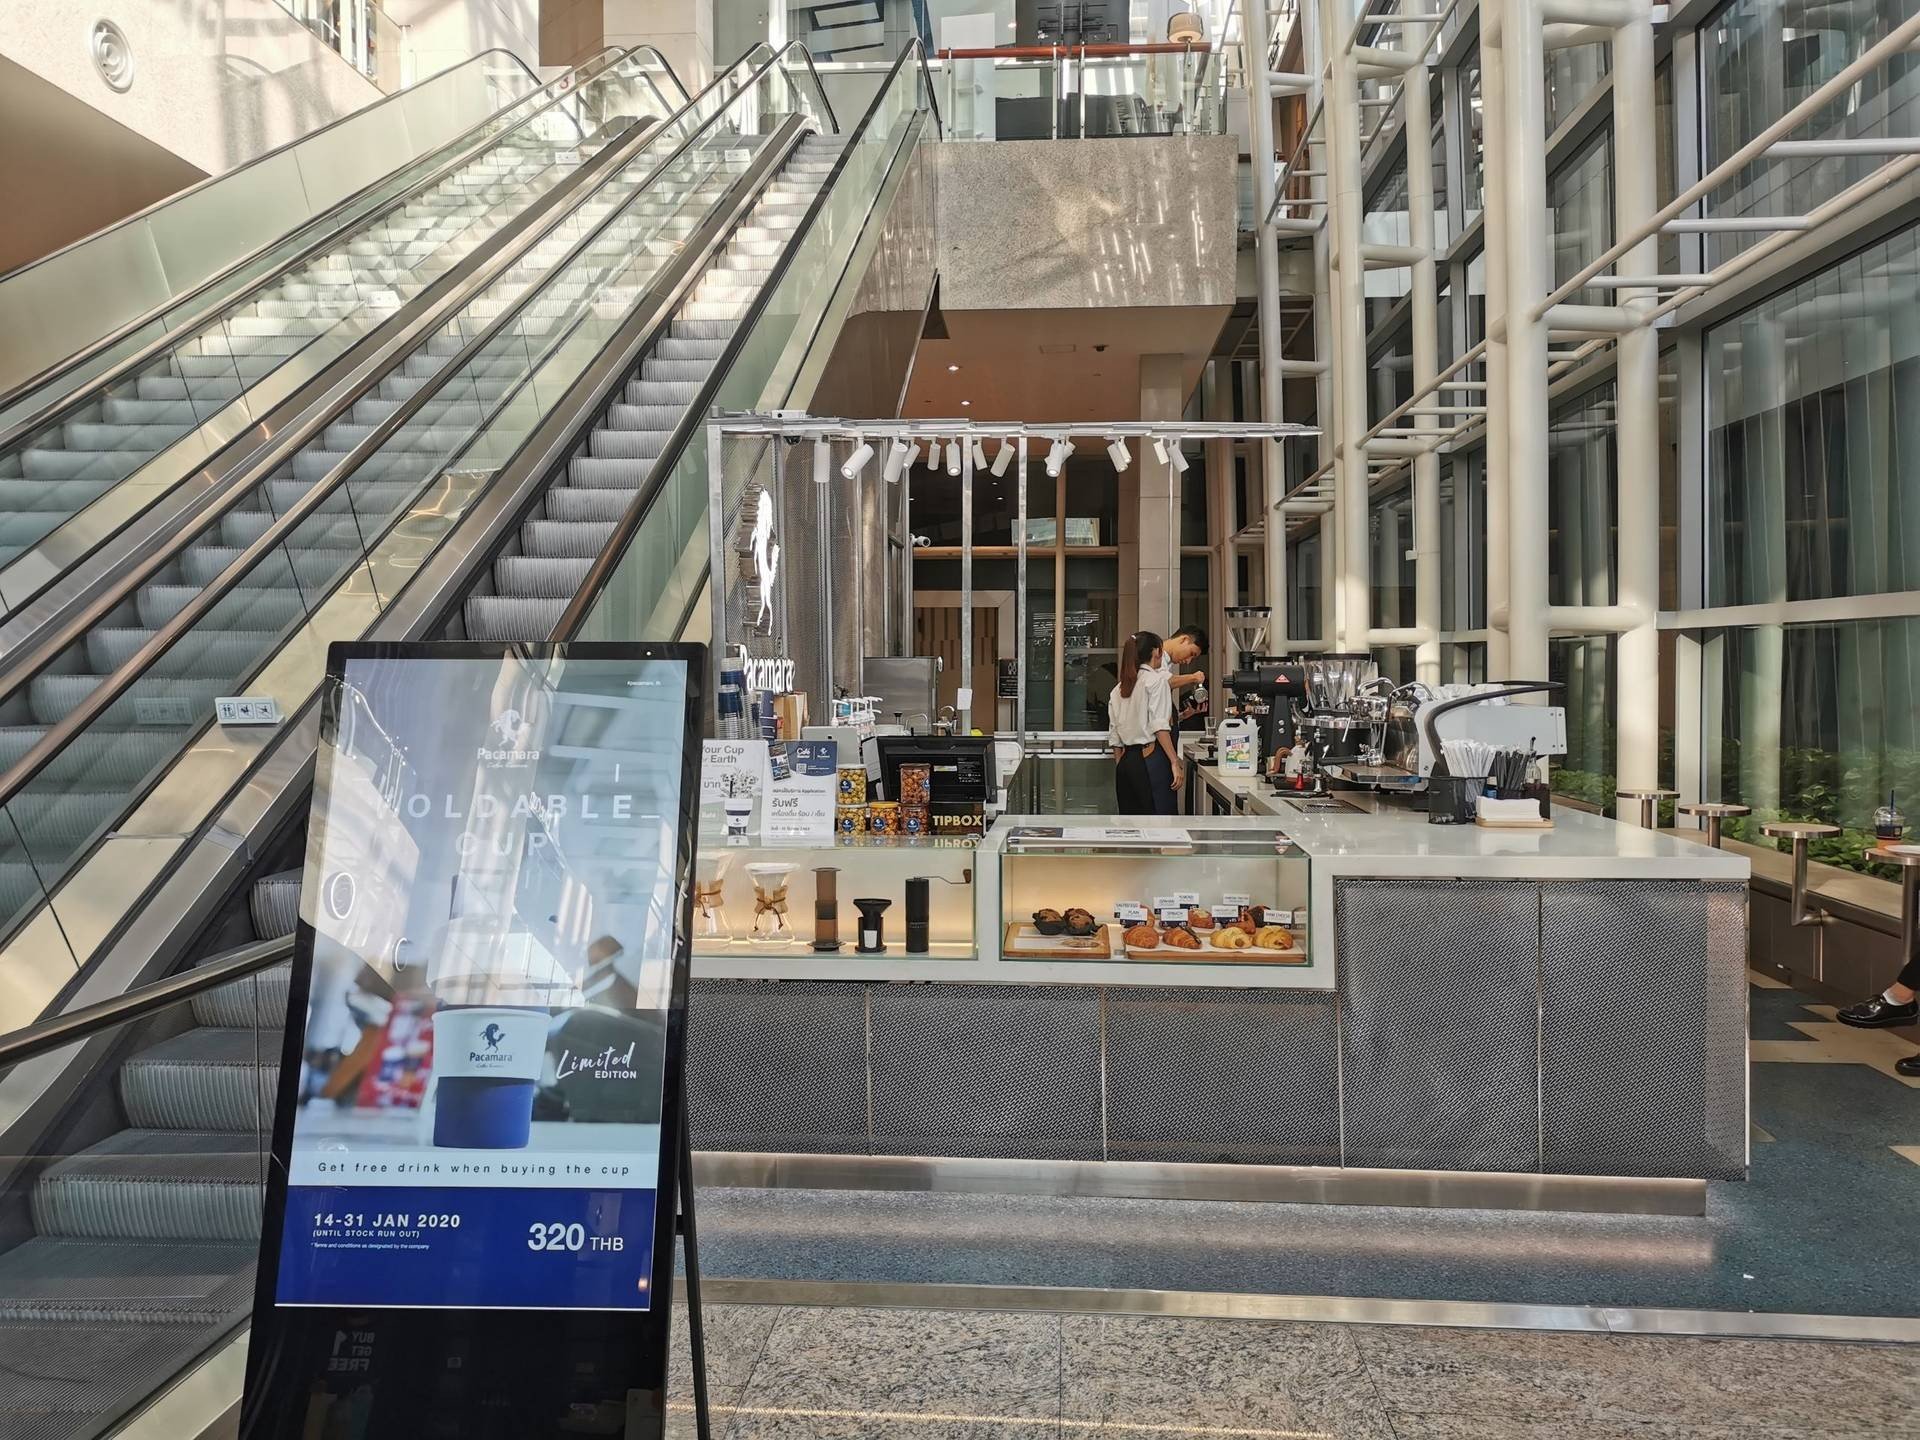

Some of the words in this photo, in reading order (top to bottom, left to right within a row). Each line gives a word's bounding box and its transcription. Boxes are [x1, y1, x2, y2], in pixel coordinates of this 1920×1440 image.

[739, 644, 796, 694] Pacamara
[477, 748, 540, 761] Pacamara
[703, 747, 721, 755] our
[724, 745, 744, 755] Cup
[710, 755, 737, 764] Earth
[376, 794, 633, 820] OLDABLE
[932, 815, 983, 826] TIPBOX
[455, 831, 550, 856] CUP
[469, 1052, 513, 1062] Pacamara
[556, 1041, 636, 1080] Limited
[594, 1070, 637, 1079] EDITION
[318, 1162, 345, 1173] Get
[355, 1162, 388, 1173] free
[398, 1162, 441, 1173] drink
[450, 1164, 491, 1174] when
[500, 1164, 556, 1176] buying
[566, 1164, 592, 1175] the
[601, 1166, 630, 1176] cup
[314, 1213, 364, 1227] 14-31
[372, 1214, 409, 1228] JAN
[417, 1214, 461, 1228] 2020
[312, 1229, 342, 1238] (UNTIL
[345, 1229, 374, 1237] STOCK
[398, 1230, 420, 1239] OUT)
[527, 1222, 585, 1252] 320
[589, 1236, 624, 1252] THB
